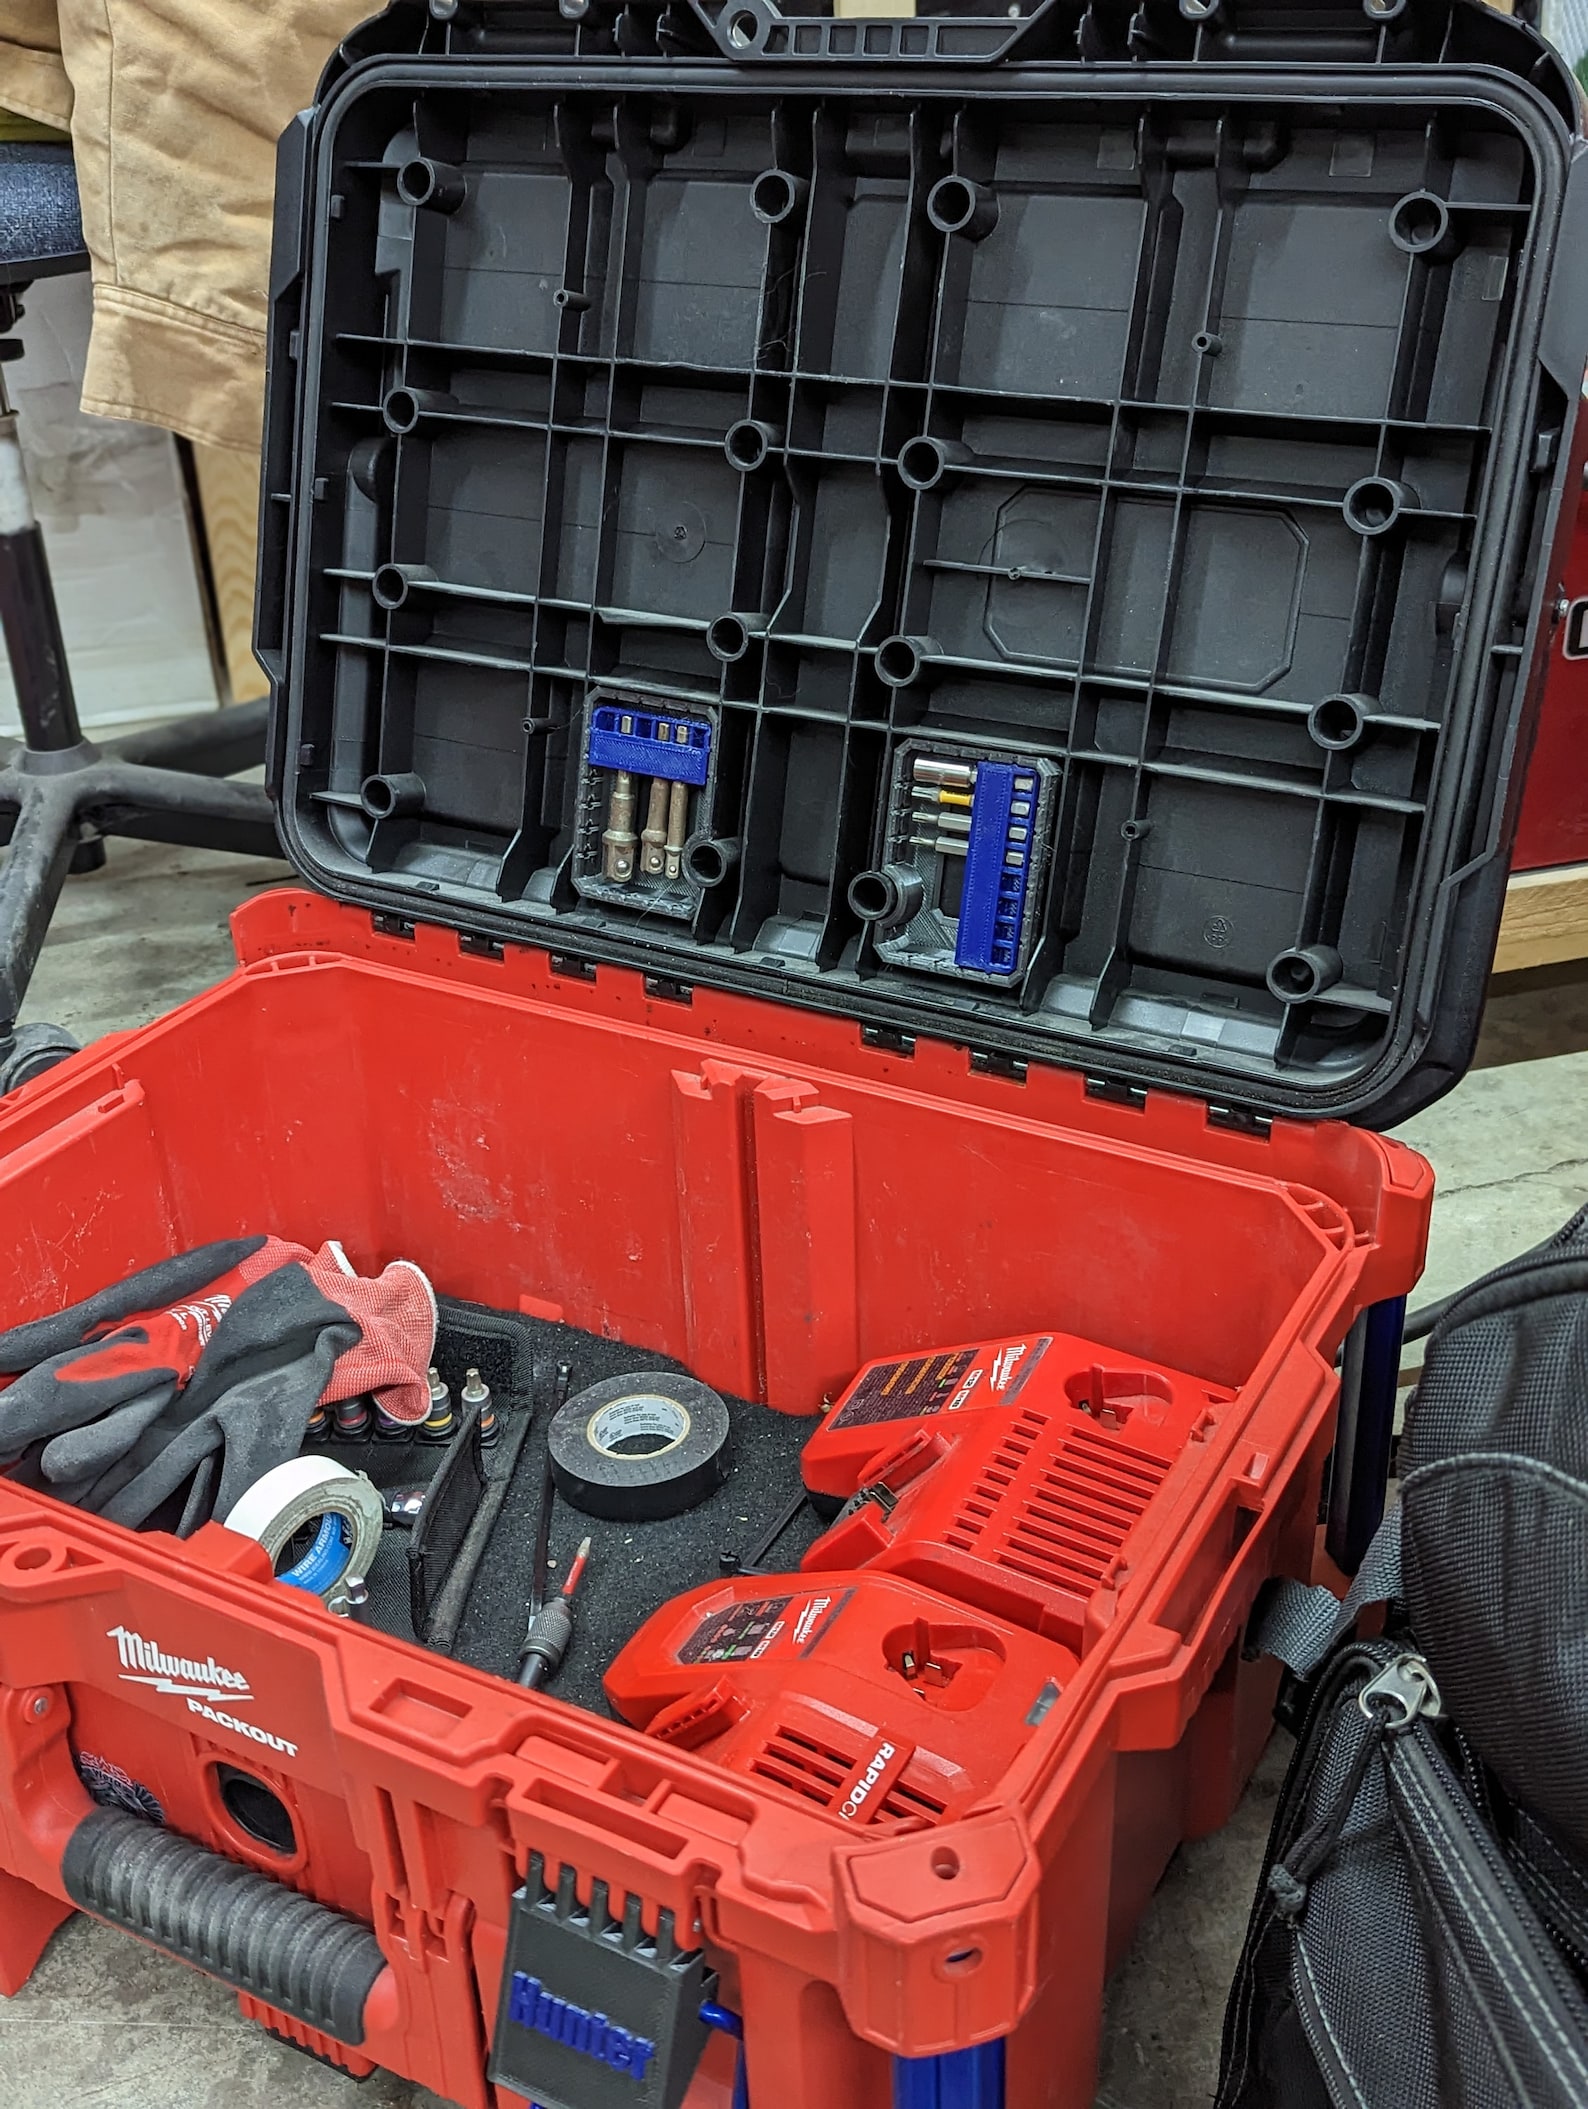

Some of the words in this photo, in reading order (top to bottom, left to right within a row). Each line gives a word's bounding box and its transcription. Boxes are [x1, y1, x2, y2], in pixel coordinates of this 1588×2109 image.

[997, 1343, 1028, 1391] Milwaukee
[291, 1553, 317, 1577] WIRE
[315, 1513, 333, 1554] ARMOU
[797, 1596, 832, 1644] Milwaukee
[106, 1625, 250, 1690] Milwaukee
[186, 1697, 299, 1758] PACKOUT
[509, 1970, 656, 2082] Hunter
